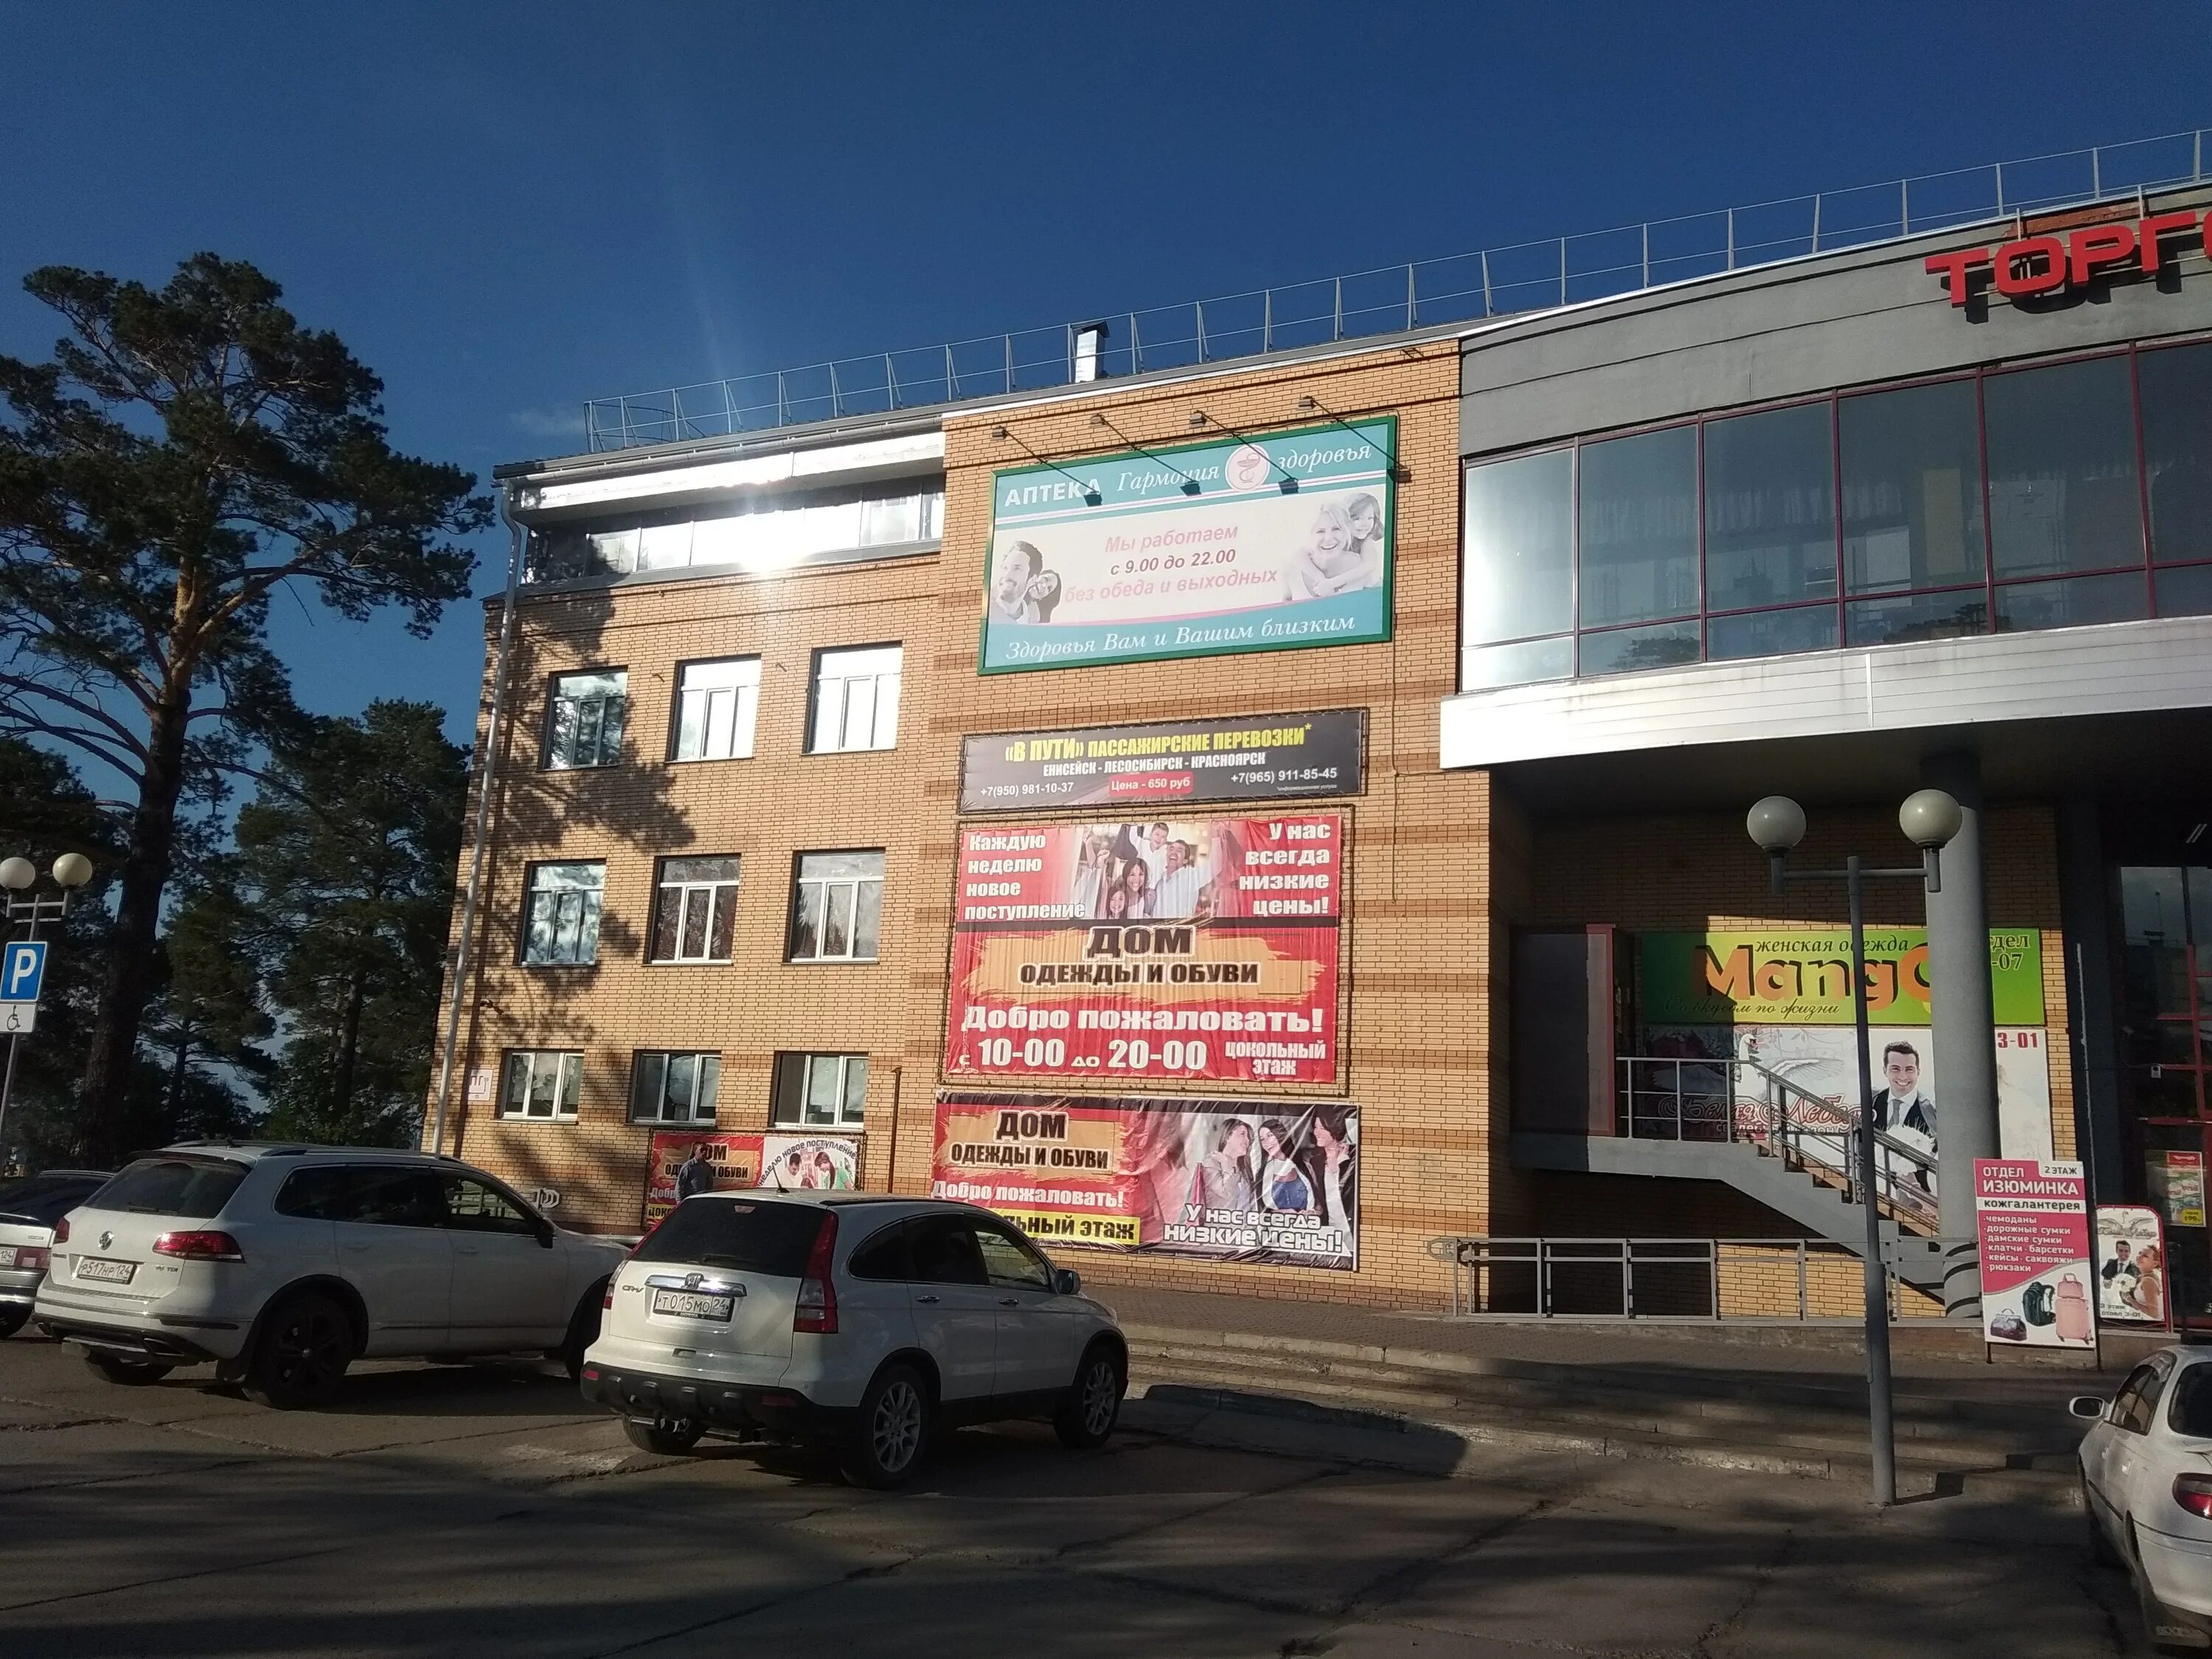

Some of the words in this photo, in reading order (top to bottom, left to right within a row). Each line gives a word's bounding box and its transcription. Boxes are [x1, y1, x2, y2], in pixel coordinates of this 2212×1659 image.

[1924, 211, 2212, 308] ТОРГ
[1004, 478, 1102, 507] АПТЕКА
[1116, 465, 1220, 495] Гармония
[1277, 445, 1371, 475] здоровья
[1105, 535, 1137, 553] Мы
[1139, 525, 1239, 553] работаем
[1110, 564, 1121, 576] с
[1125, 557, 1160, 575] 9.00
[1163, 554, 1186, 572] до
[1191, 548, 1237, 567] 22.00
[1064, 582, 1096, 604] без
[1099, 578, 1155, 600] обеда
[1160, 579, 1170, 593] и
[1175, 568, 1278, 593] выходных
[1005, 640, 1097, 661] Здоровья
[1102, 632, 1147, 652] Вам
[1153, 633, 1167, 646] и
[1175, 625, 1253, 646] Вашим
[1260, 617, 1356, 638] близким
[1087, 732, 1211, 758] ПАССАЖИРСКИЕ
[1043, 760, 1097, 777] ЕНИСЕЙСК
[1103, 756, 1183, 774] ЛЕСОСИБИРСК
[1190, 751, 1267, 769] КРАСНОЯРСК
[1110, 777, 1139, 793] Цена
[1147, 776, 1168, 790] 650
[1169, 776, 1191, 793] руб
[1231, 768, 1276, 785] +7(965)
[1278, 767, 1338, 782] 911-85-45
[980, 782, 1020, 798] +7(950)
[1021, 780, 1074, 796] 981-10-37
[1268, 822, 1286, 841] У
[1287, 822, 1332, 840] нас
[970, 832, 1047, 852] Каждую
[1244, 846, 1331, 868] всегда
[967, 858, 1043, 876] неделю
[966, 880, 1021, 898] новое
[1239, 873, 1330, 891] низкие
[964, 902, 1086, 922] поступление
[1252, 897, 1329, 917] цены!
[1086, 925, 1197, 961] ДОМ
[1755, 939, 1832, 954] женская
[1989, 934, 2031, 952] дел
[11, 948, 36, 994] P
[1992, 953, 2024, 970] -07
[1019, 962, 1141, 987] ОДЕЖДЫ
[1147, 964, 1164, 984] И
[1169, 962, 1259, 985] ОБУВИ
[961, 1005, 1071, 1034] Добро
[1075, 1007, 1324, 1034] пожаловать!
[1756, 1005, 1777, 1014] по
[1780, 998, 1840, 1022] жизни
[1997, 1032, 2038, 1048] 3-01
[978, 1038, 1065, 1067] 10-00
[1107, 1038, 1208, 1070] 20-00
[1252, 1058, 1297, 1076] этаж
[995, 1111, 1071, 1143] ДОМ
[782, 1142, 805, 1158] новое
[806, 1139, 857, 1160] поступление
[950, 1142, 1033, 1167] ОДЕЖДЫ
[1034, 1145, 1047, 1166] И
[1049, 1146, 1109, 1170] ОБУВИ
[717, 1164, 749, 1179] ОБУВИ
[1983, 1166, 2024, 1179] ОТДЕЛ
[2052, 1166, 2078, 1175] ЭТАЖ
[650, 1187, 677, 1200] Добр
[931, 1180, 992, 1200] Добро
[995, 1186, 1124, 1208] пожаловать!
[1983, 1179, 2079, 1195] ИЗЮМИНКА
[1984, 1200, 2080, 1211] кожгалантерея
[1186, 1203, 1203, 1222] У
[1206, 1208, 1244, 1225] нас
[1246, 1211, 1321, 1230] всегда
[1986, 1215, 2037, 1224] чемоданы
[1079, 1220, 1135, 1239] этаж
[1164, 1223, 1256, 1245] низкие
[1261, 1229, 1343, 1252] цены!
[1986, 1225, 2038, 1235] дорожные
[2040, 1227, 2071, 1236] сумки
[1987, 1234, 2029, 1243] дамские
[2032, 1237, 2062, 1245] сумки
[1989, 1253, 2019, 1262] кейсы
[2025, 1255, 2073, 1264] саквояжи
[2028, 1244, 2074, 1255] барсетки
[1989, 1264, 2031, 1273] рюкзаки
[712, 1298, 726, 1310] 24
